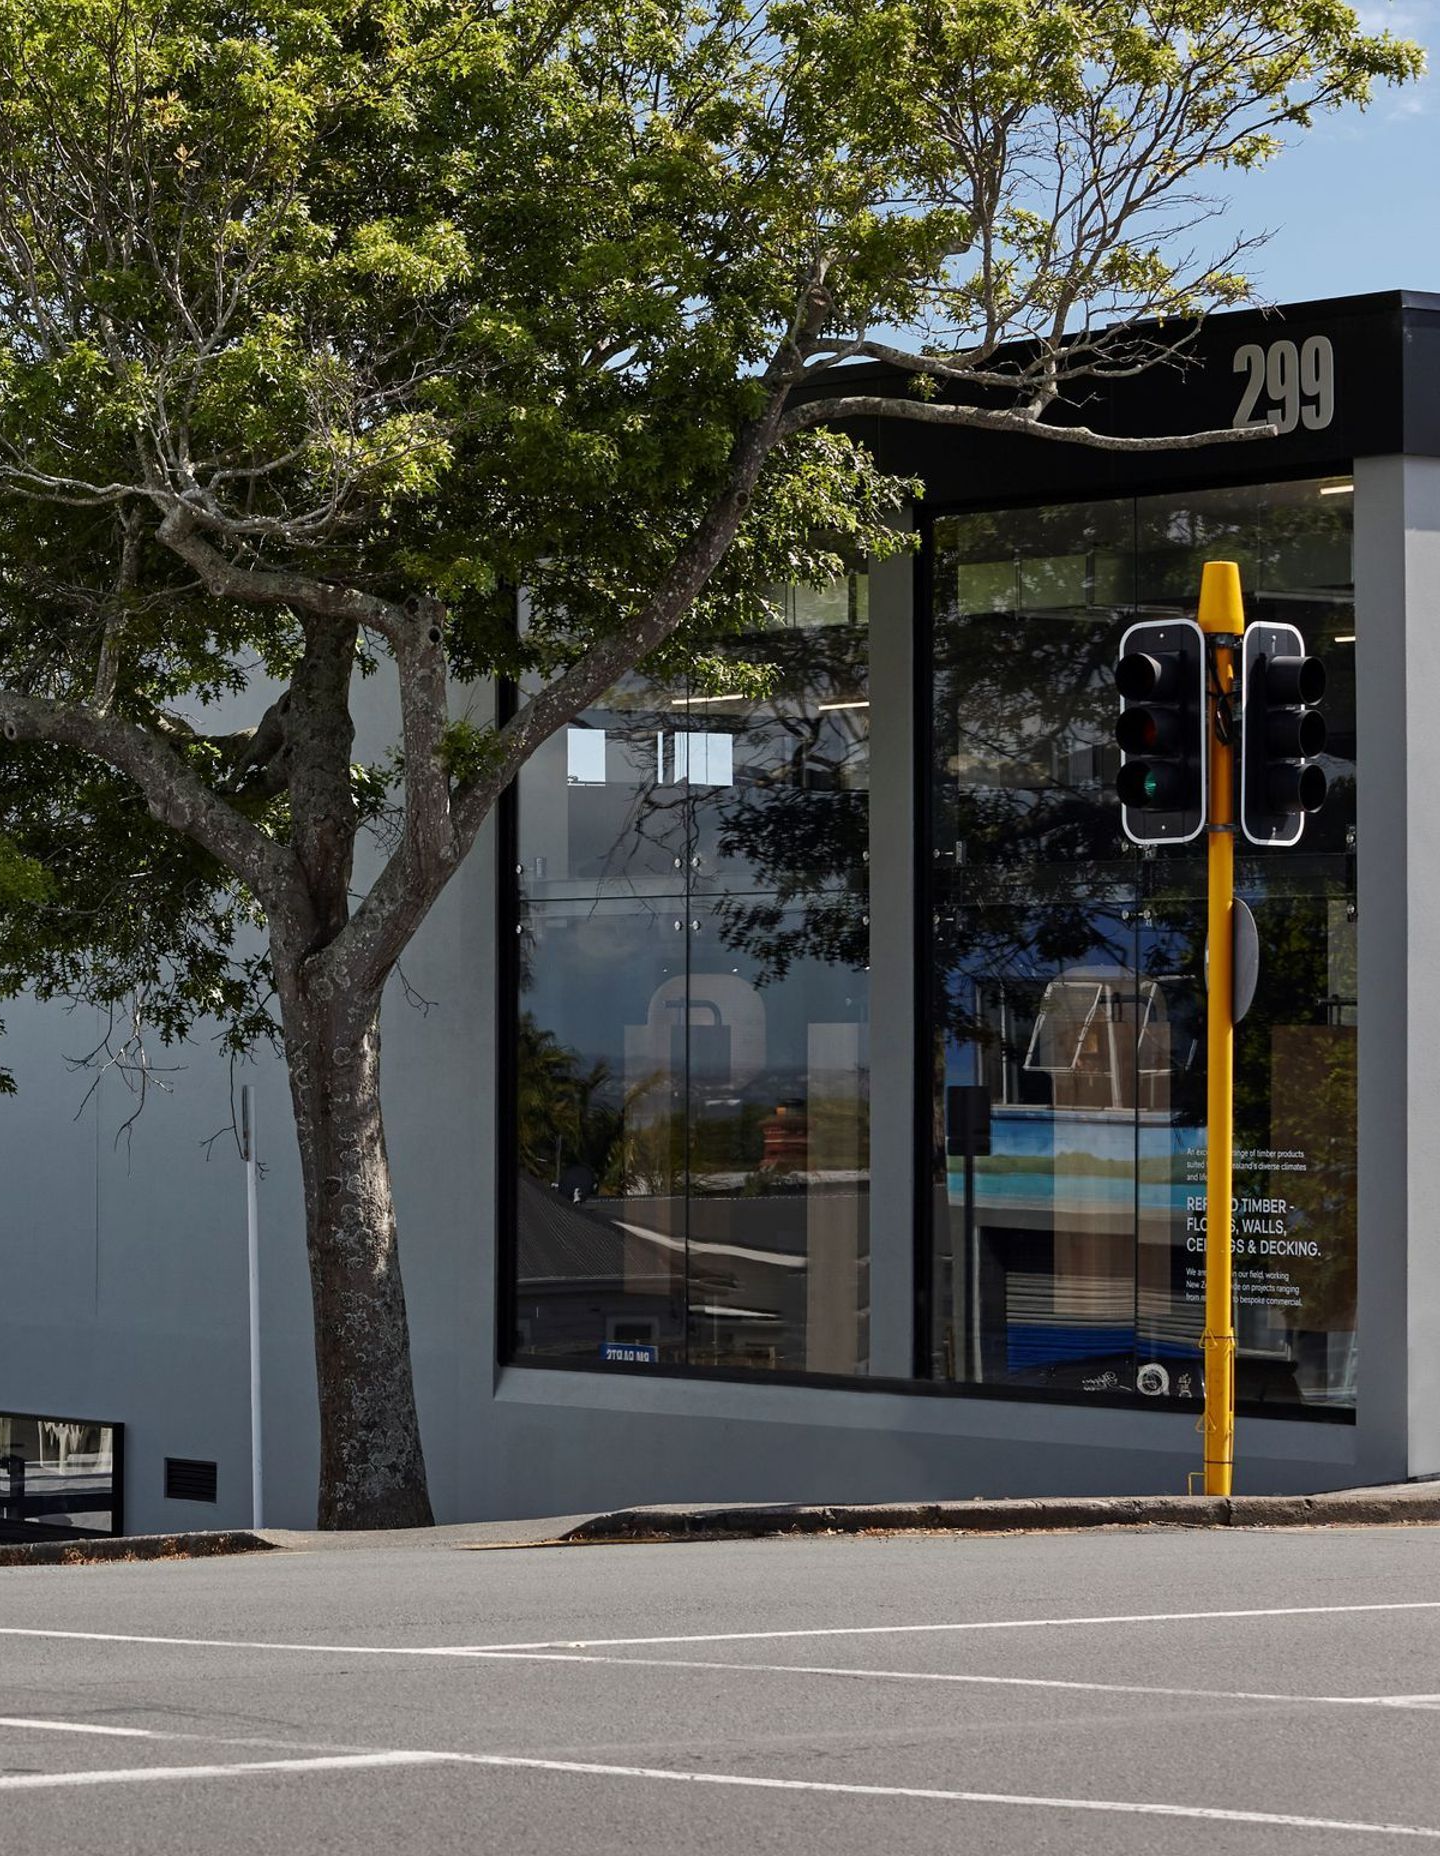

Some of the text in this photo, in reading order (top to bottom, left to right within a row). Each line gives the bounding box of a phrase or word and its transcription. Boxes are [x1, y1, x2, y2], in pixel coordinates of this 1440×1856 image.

[1232, 335, 1334, 434] 299
[1249, 1148, 1256, 1157] of
[1256, 1149, 1276, 1158] timber
[1277, 1150, 1305, 1160] products
[1187, 1160, 1307, 1172] suited ealand's diverse climates
[1187, 1173, 1199, 1181] and
[1186, 1196, 1238, 1212] REFD
[1240, 1199, 1287, 1214] TIMBER
[1186, 1217, 1287, 1237] FLOS, WALLS,
[1186, 1237, 1322, 1257] CEIGS & DECKING.
[1186, 1267, 1196, 1276] We
[1238, 1271, 1249, 1279] our
[1265, 1272, 1290, 1282] working
[1186, 1280, 1200, 1289] New
[1251, 1284, 1275, 1294] projects
[1276, 1286, 1300, 1296] ranging
[1186, 1292, 1200, 1301] from
[1240, 1296, 1265, 1307] bespoke
